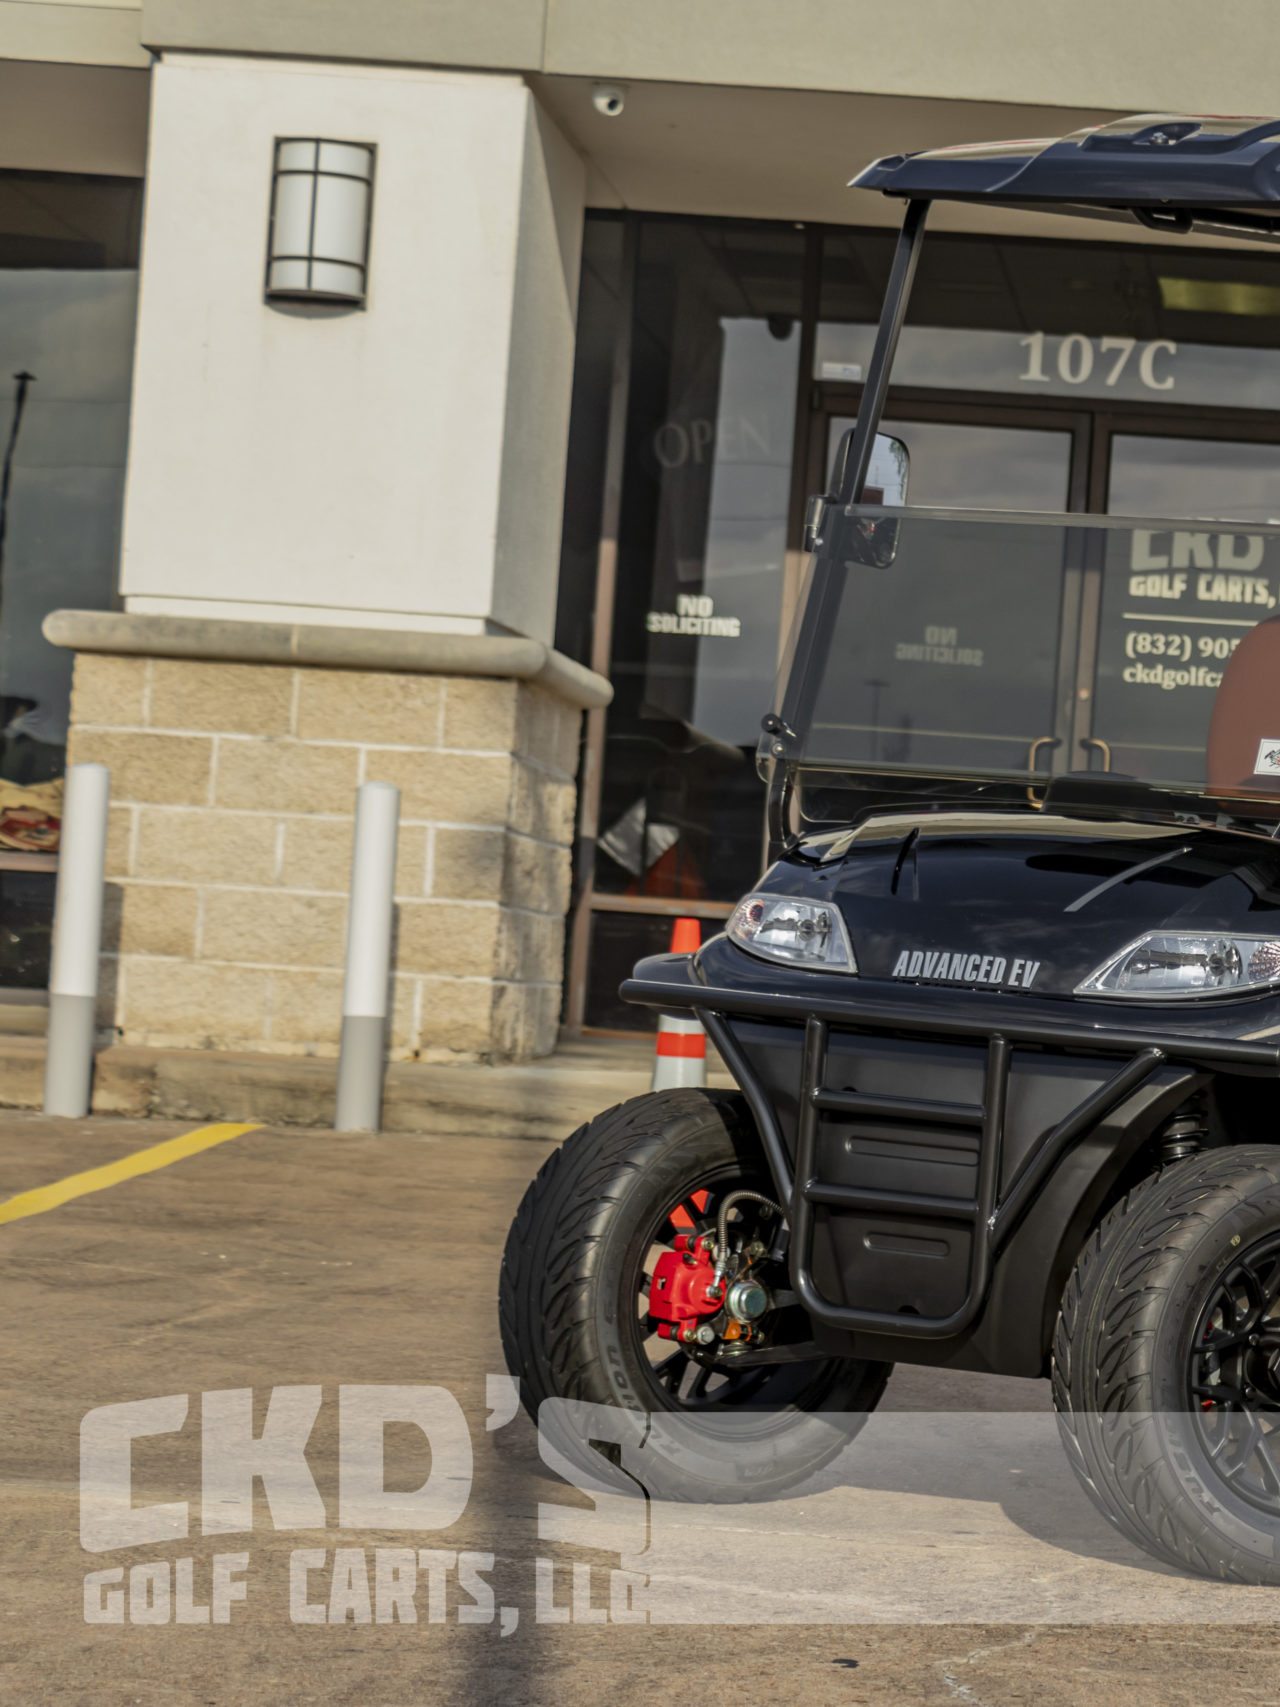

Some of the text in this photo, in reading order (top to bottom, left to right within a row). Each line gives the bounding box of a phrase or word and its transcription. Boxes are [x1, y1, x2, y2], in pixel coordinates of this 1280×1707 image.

[1018, 331, 1178, 391] 107C
[654, 415, 773, 469] OPEN
[676, 594, 714, 617] NO
[1128, 573, 1188, 599] GOLF
[1197, 575, 1277, 609] CARTS,
[647, 612, 741, 637] SOLICITING
[1125, 631, 1192, 662] (832)
[892, 950, 1041, 988] ADVANCED EV
